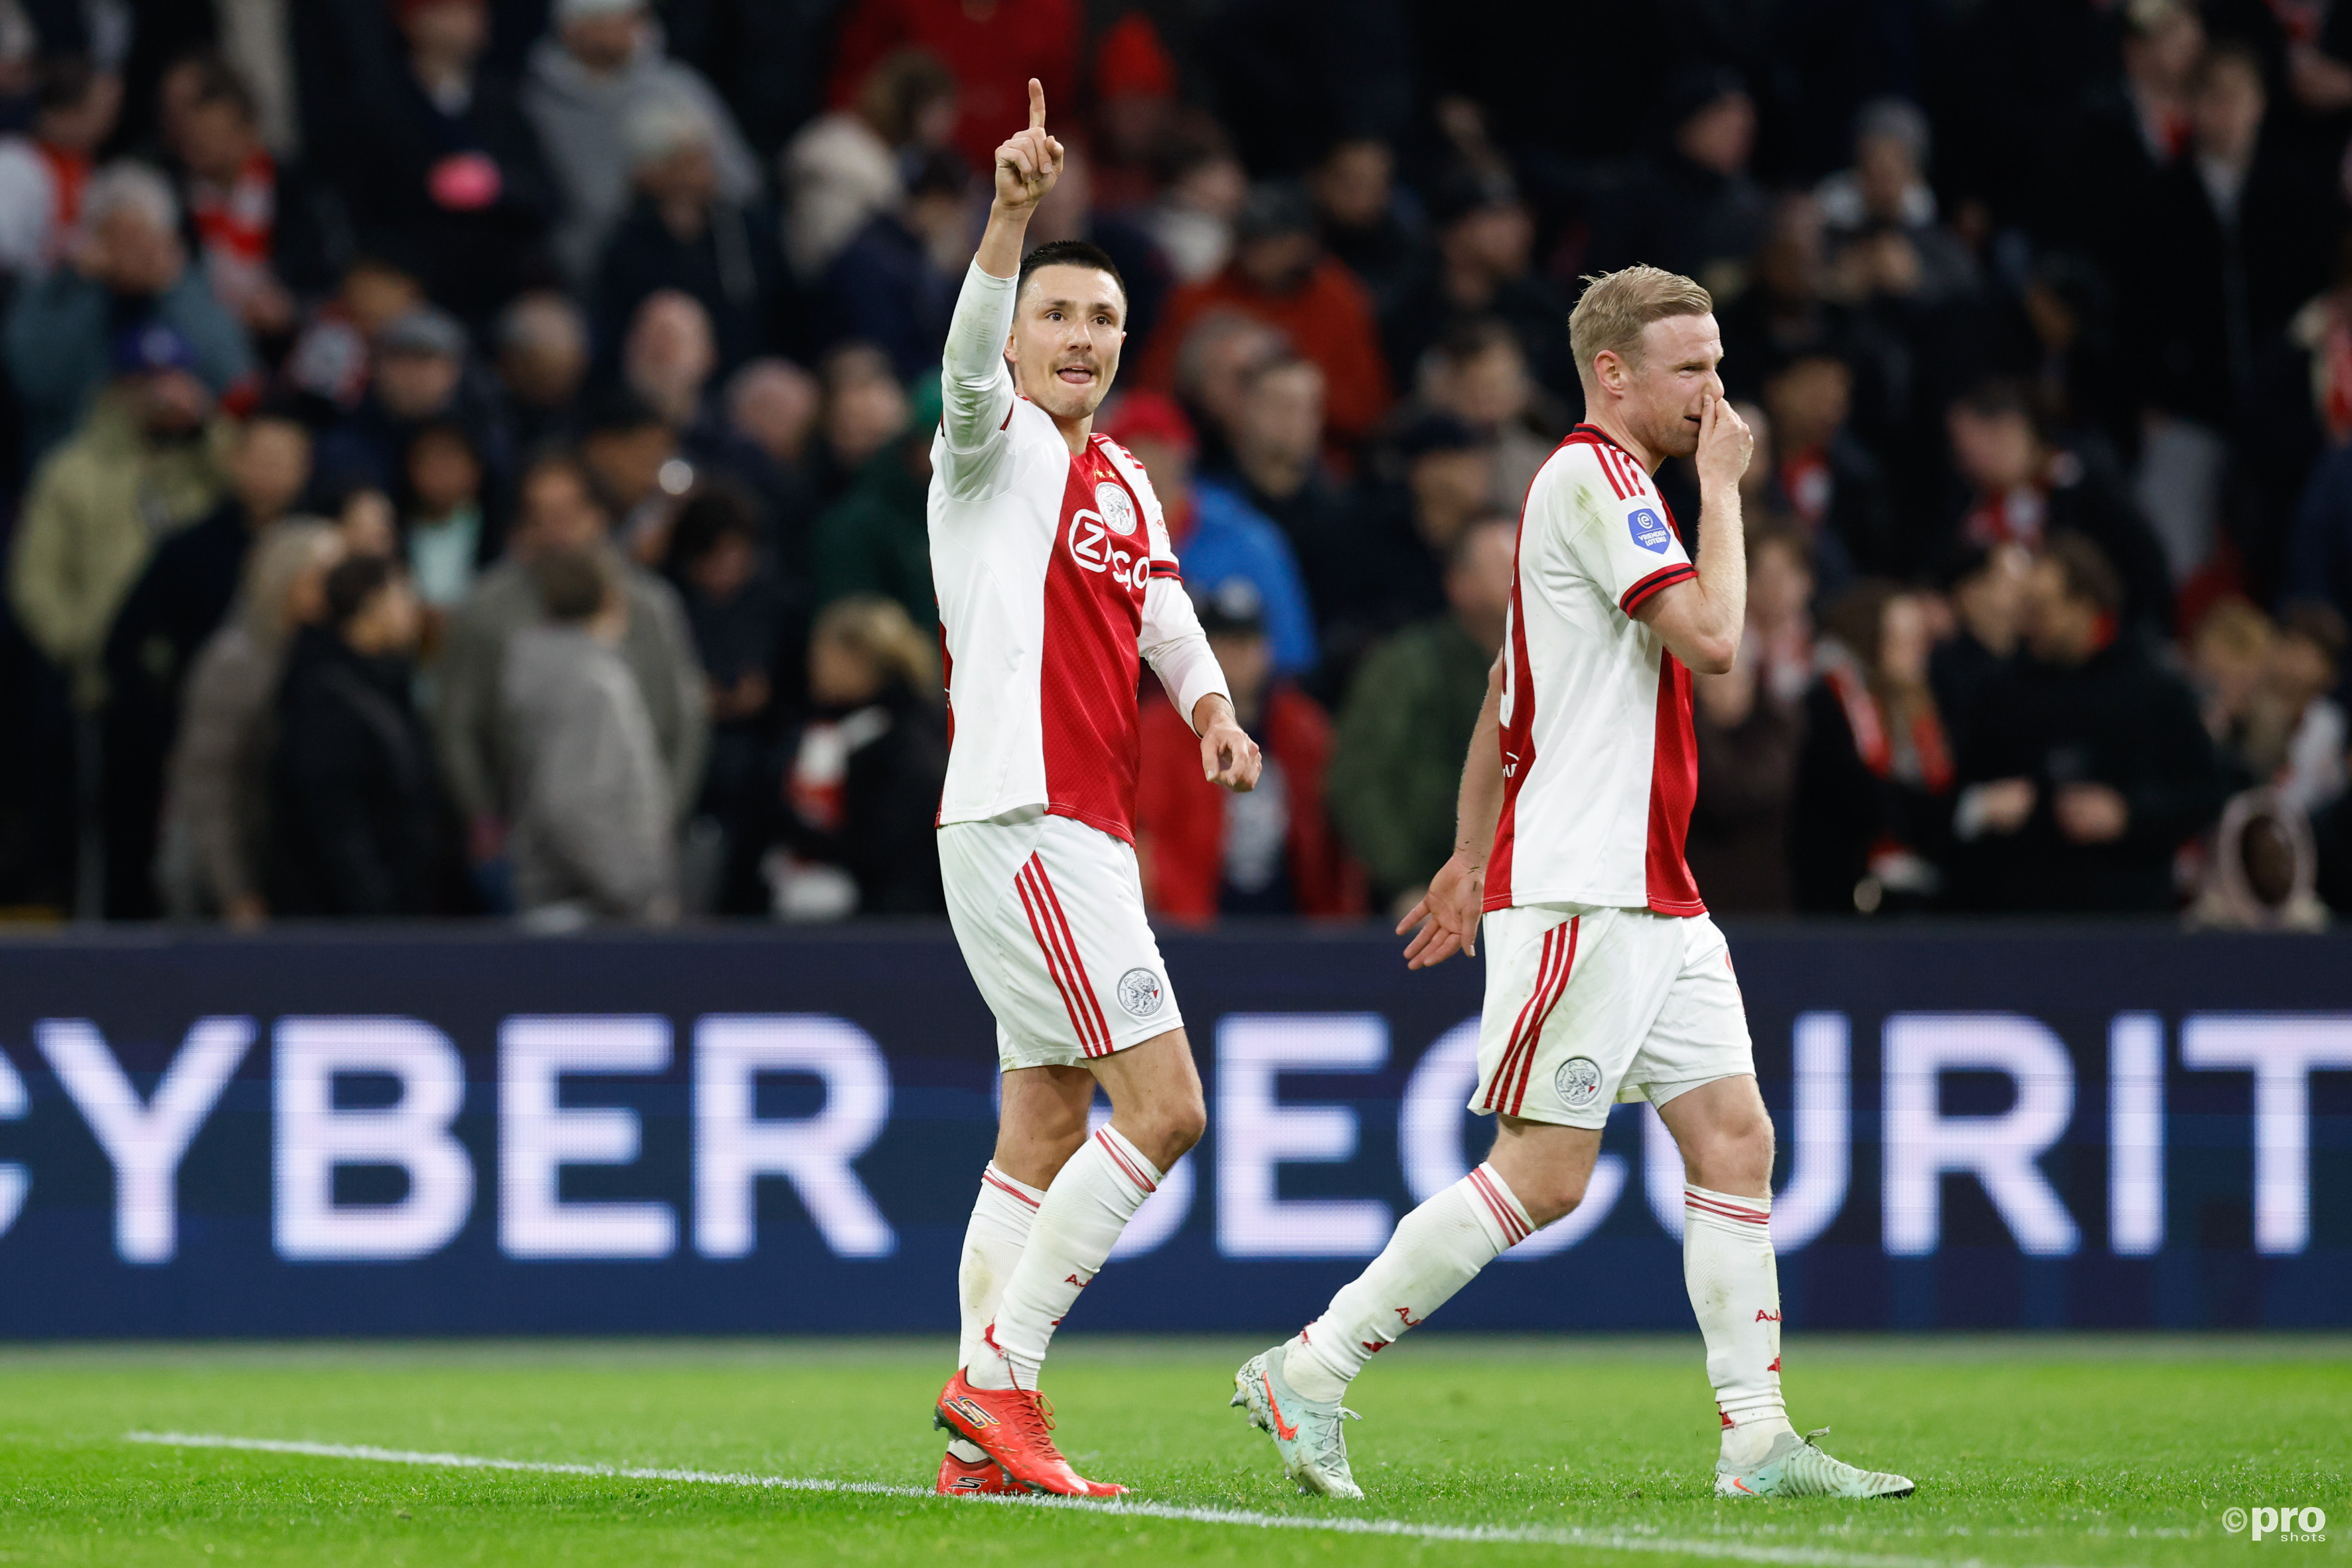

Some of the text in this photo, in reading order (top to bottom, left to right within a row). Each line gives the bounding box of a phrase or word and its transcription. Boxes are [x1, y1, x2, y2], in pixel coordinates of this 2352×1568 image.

[1638, 530, 1667, 541] VRIENDEN
[1644, 536, 1667, 547] LOTERIJ
[0, 1016, 900, 1259] YBER
